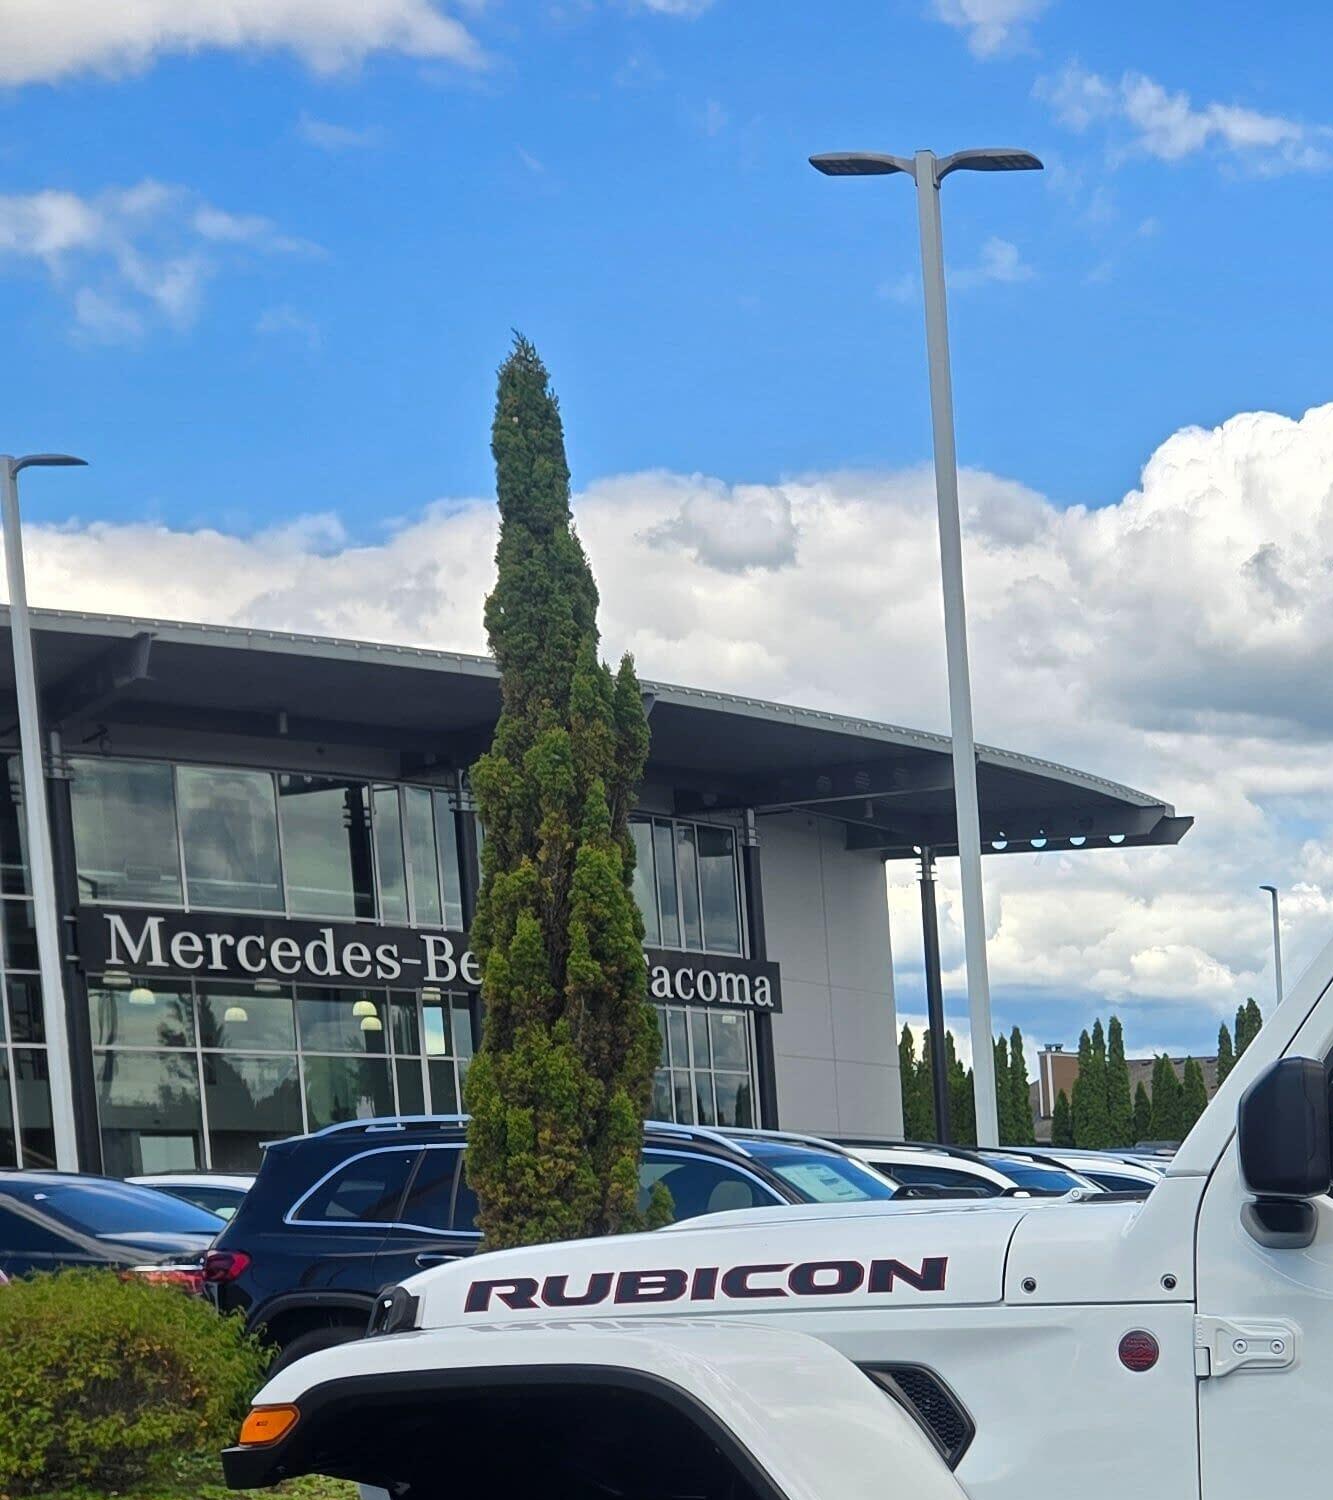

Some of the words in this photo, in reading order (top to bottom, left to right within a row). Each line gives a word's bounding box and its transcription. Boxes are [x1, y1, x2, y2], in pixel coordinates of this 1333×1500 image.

[103, 913, 484, 985] Mercedes-Be
[643, 954, 774, 1007] acoma
[464, 1256, 949, 1313] RUBICON
